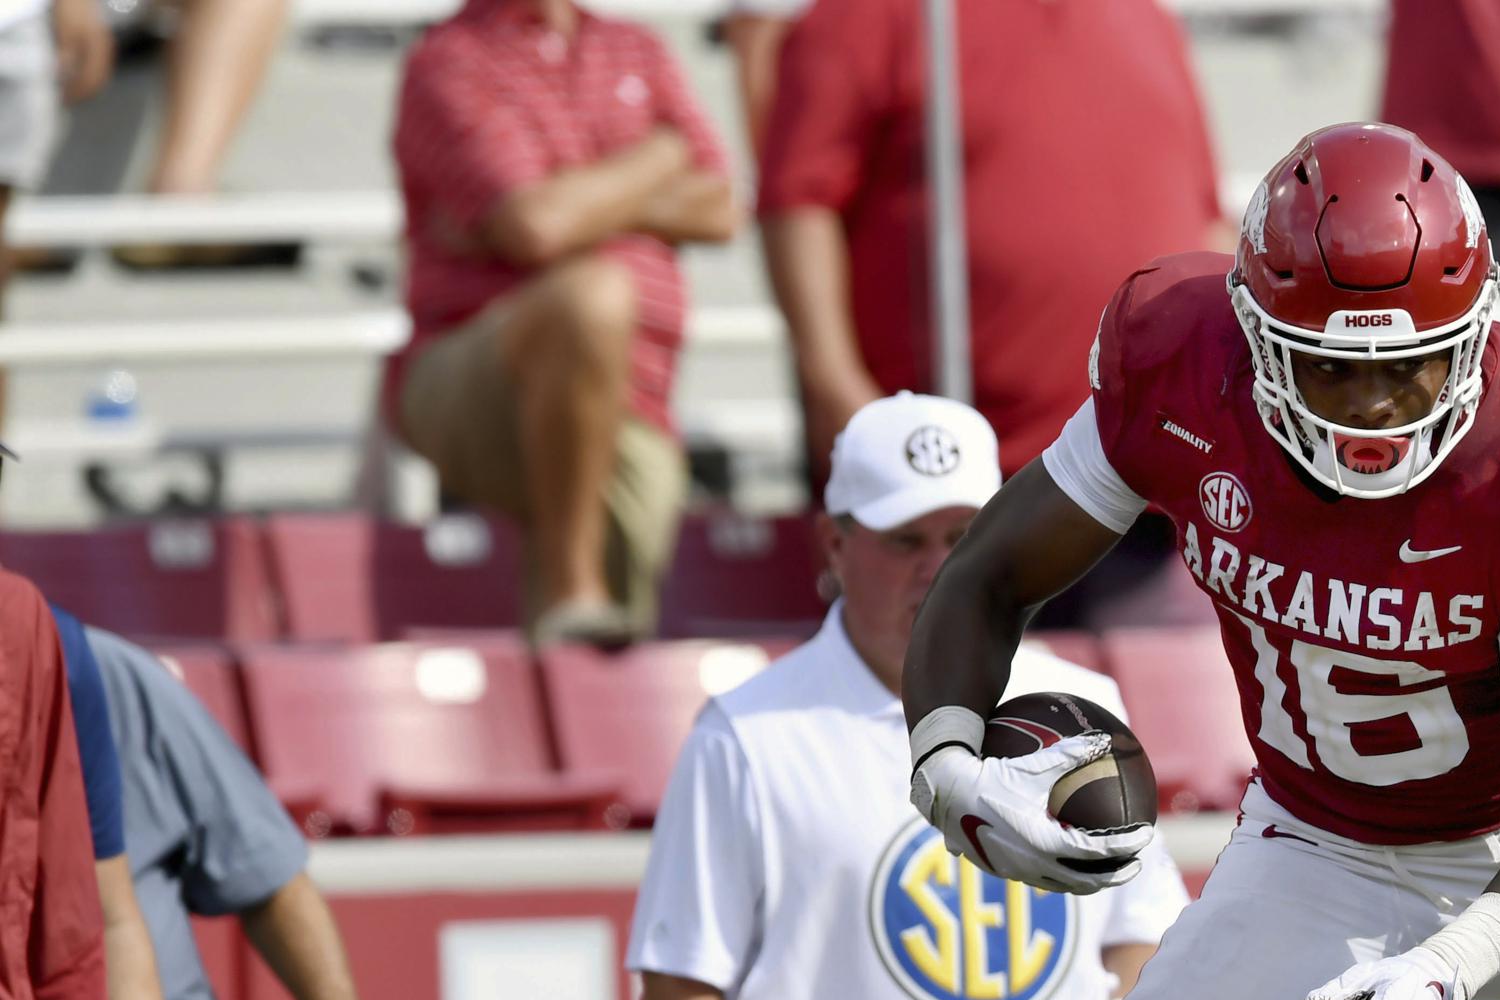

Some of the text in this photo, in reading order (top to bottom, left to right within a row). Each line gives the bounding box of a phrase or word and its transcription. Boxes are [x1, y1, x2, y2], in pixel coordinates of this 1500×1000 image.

[1345, 314, 1393, 327] HOGS
[1163, 420, 1212, 454] EQUALITY
[1203, 477, 1246, 529] SEC
[1184, 521, 1484, 652] ARKANSAS
[1218, 600, 1471, 787] 16
